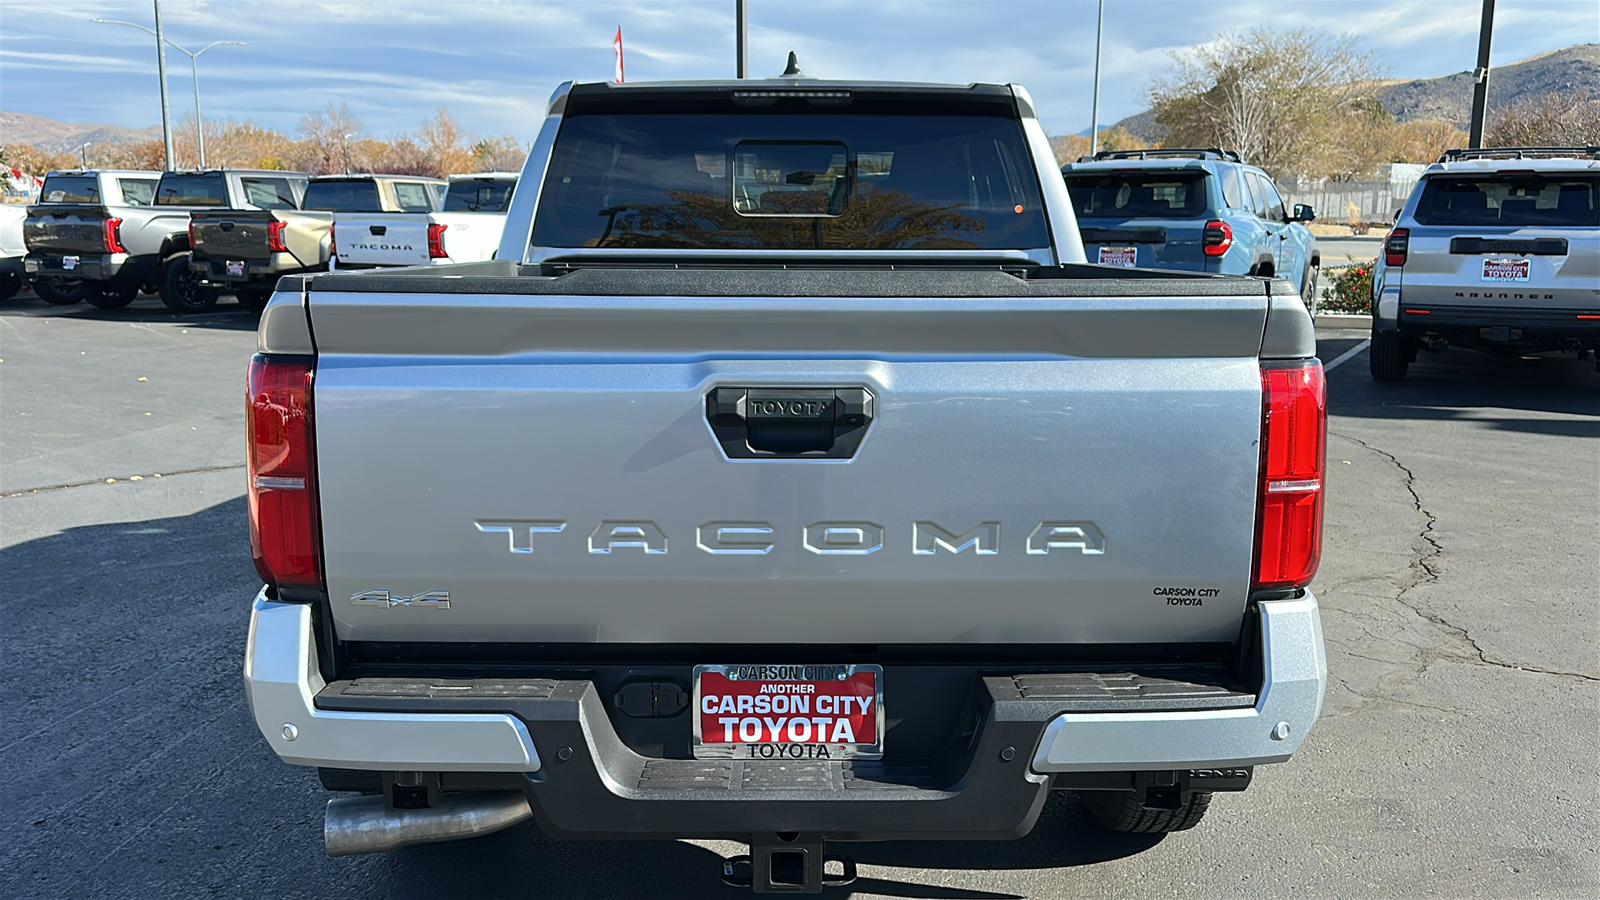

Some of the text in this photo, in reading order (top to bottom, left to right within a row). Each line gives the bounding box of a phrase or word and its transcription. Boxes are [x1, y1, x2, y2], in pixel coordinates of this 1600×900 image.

[349, 243, 413, 251] TACOMA
[1484, 264, 1512, 272] CARSON
[1488, 270, 1523, 278] TOYOTA
[1455, 292, 1553, 300] 4RUNNER
[751, 401, 831, 416] TOYOTA
[474, 518, 1107, 555] TACOMA
[1153, 587, 1221, 597] CARSON CITY
[1166, 597, 1203, 606] TOYOTA
[738, 665, 837, 680] CARSON CITY
[760, 684, 815, 694] ANOTHER
[702, 695, 873, 715] CARSON CITY
[718, 716, 856, 743] TOYOTA
[747, 744, 831, 758] TOYOTA
